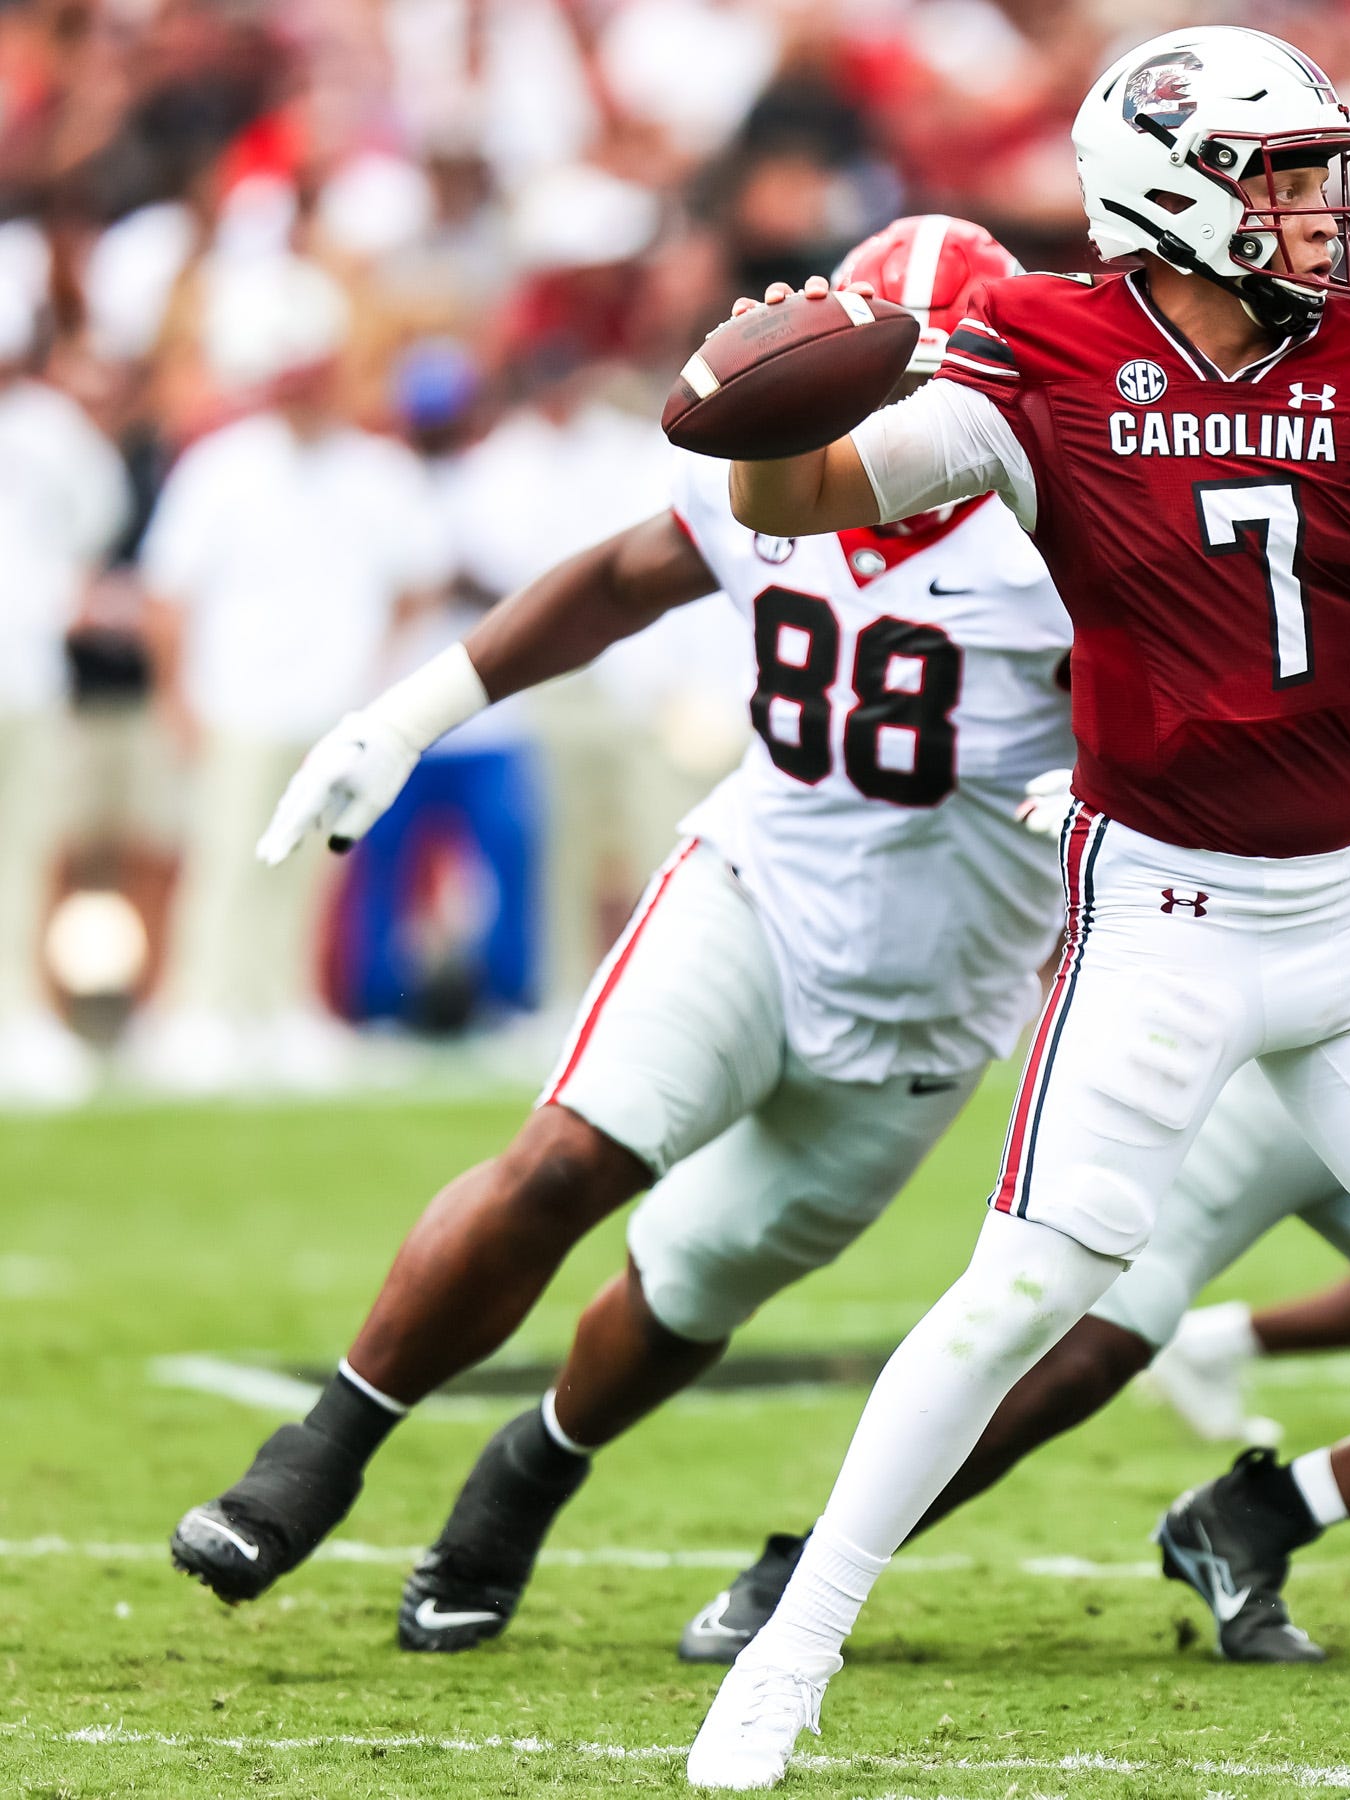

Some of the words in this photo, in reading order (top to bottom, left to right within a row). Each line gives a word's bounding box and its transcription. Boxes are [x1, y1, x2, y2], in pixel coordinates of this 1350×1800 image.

[1108, 410, 1337, 463] CAROLINA
[1118, 361, 1165, 402] SEC
[1195, 477, 1312, 690] 7
[750, 584, 965, 810] 88
